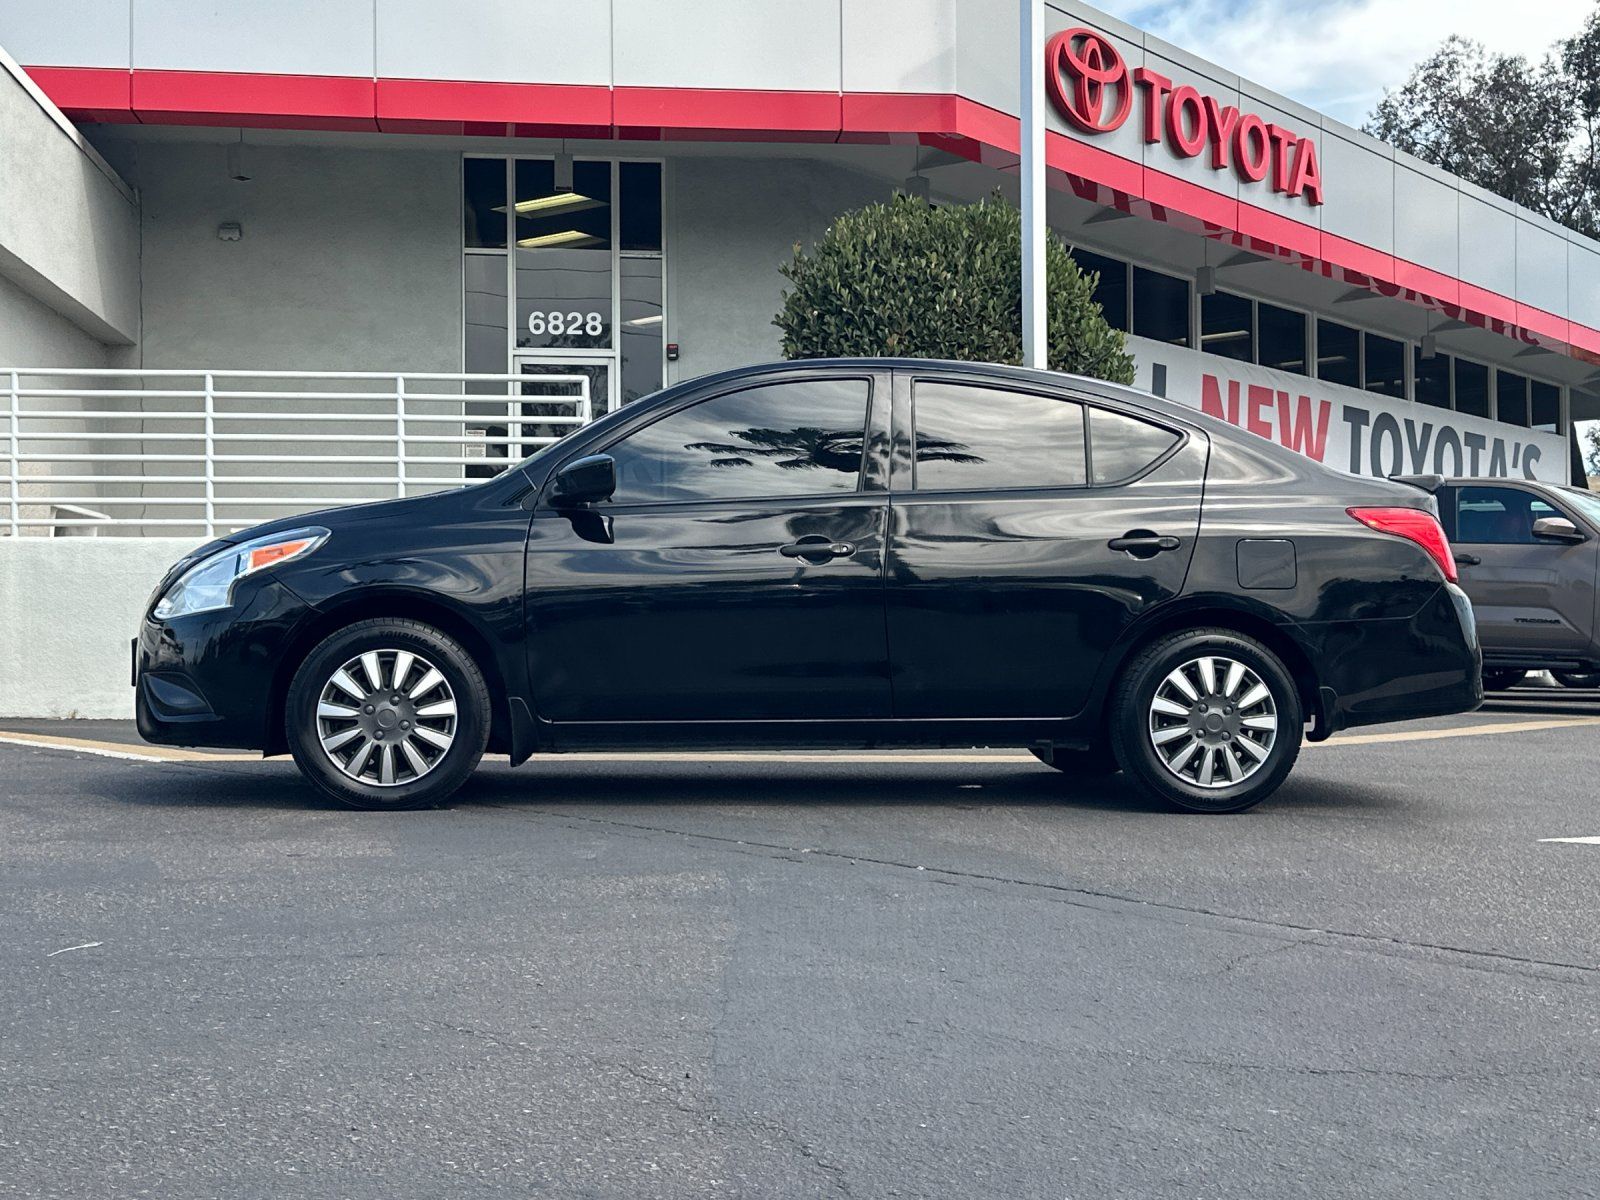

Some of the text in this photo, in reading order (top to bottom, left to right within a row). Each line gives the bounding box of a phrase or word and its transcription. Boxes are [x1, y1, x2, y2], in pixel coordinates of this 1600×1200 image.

[1134, 67, 1323, 205] TOYOTA
[528, 311, 603, 336] 6828
[1201, 373, 1332, 464] NEW
[1343, 405, 1542, 480] TOYOTA'S
